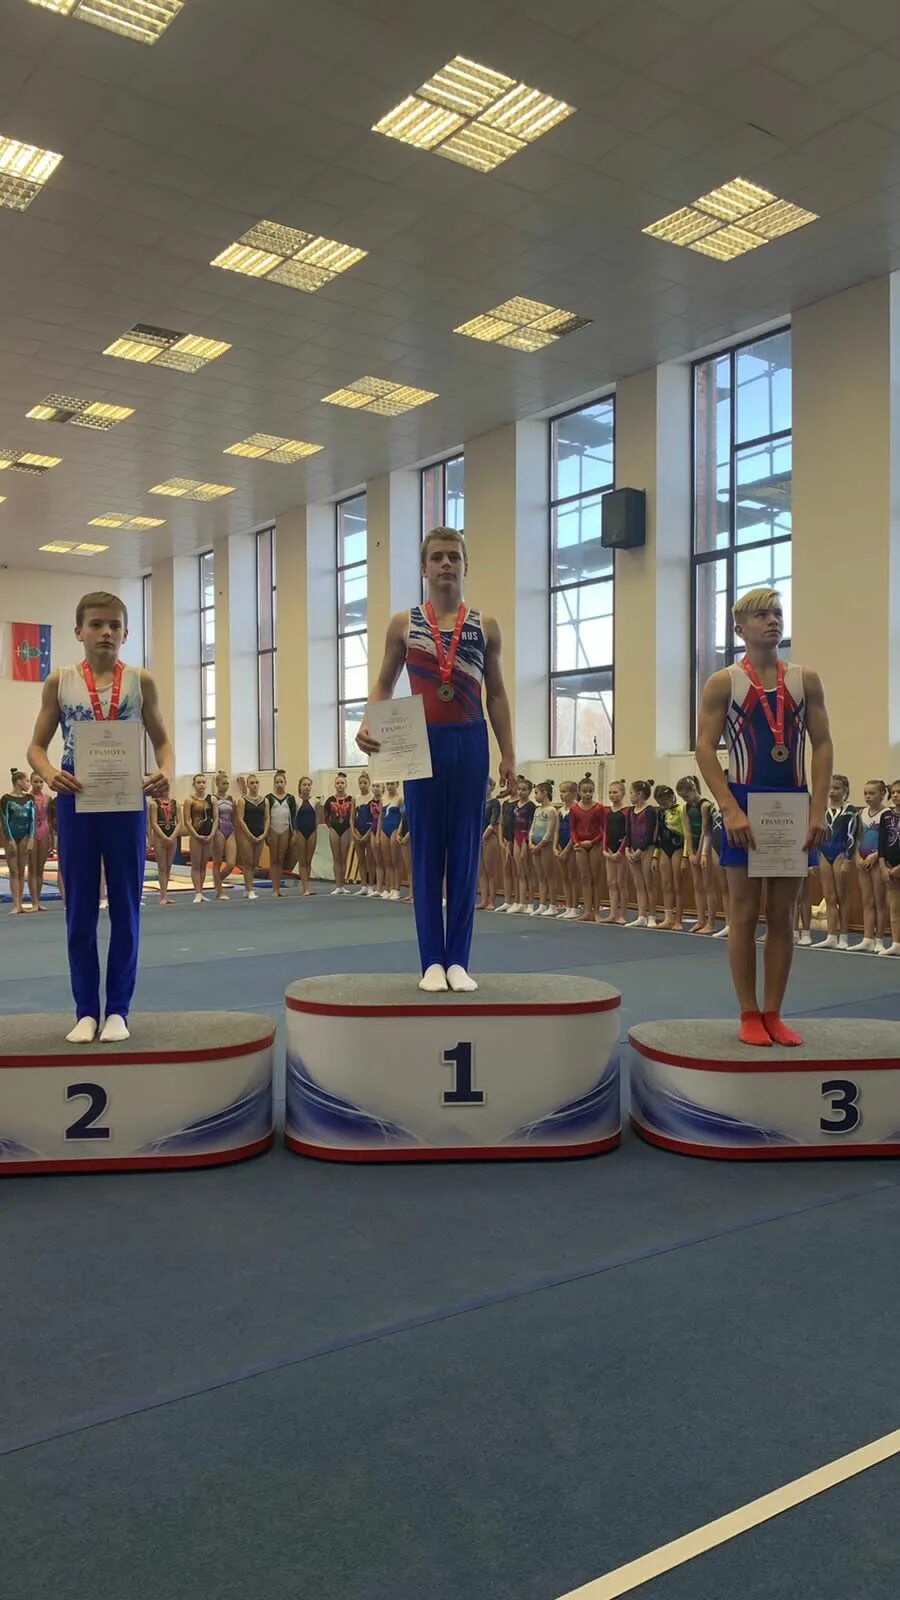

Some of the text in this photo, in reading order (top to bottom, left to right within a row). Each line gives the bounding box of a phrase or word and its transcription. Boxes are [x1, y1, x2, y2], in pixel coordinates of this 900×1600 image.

[461, 631, 478, 640] RUS
[442, 1041, 485, 1104] 1
[65, 1082, 110, 1140] 2
[820, 1079, 860, 1133] 3
